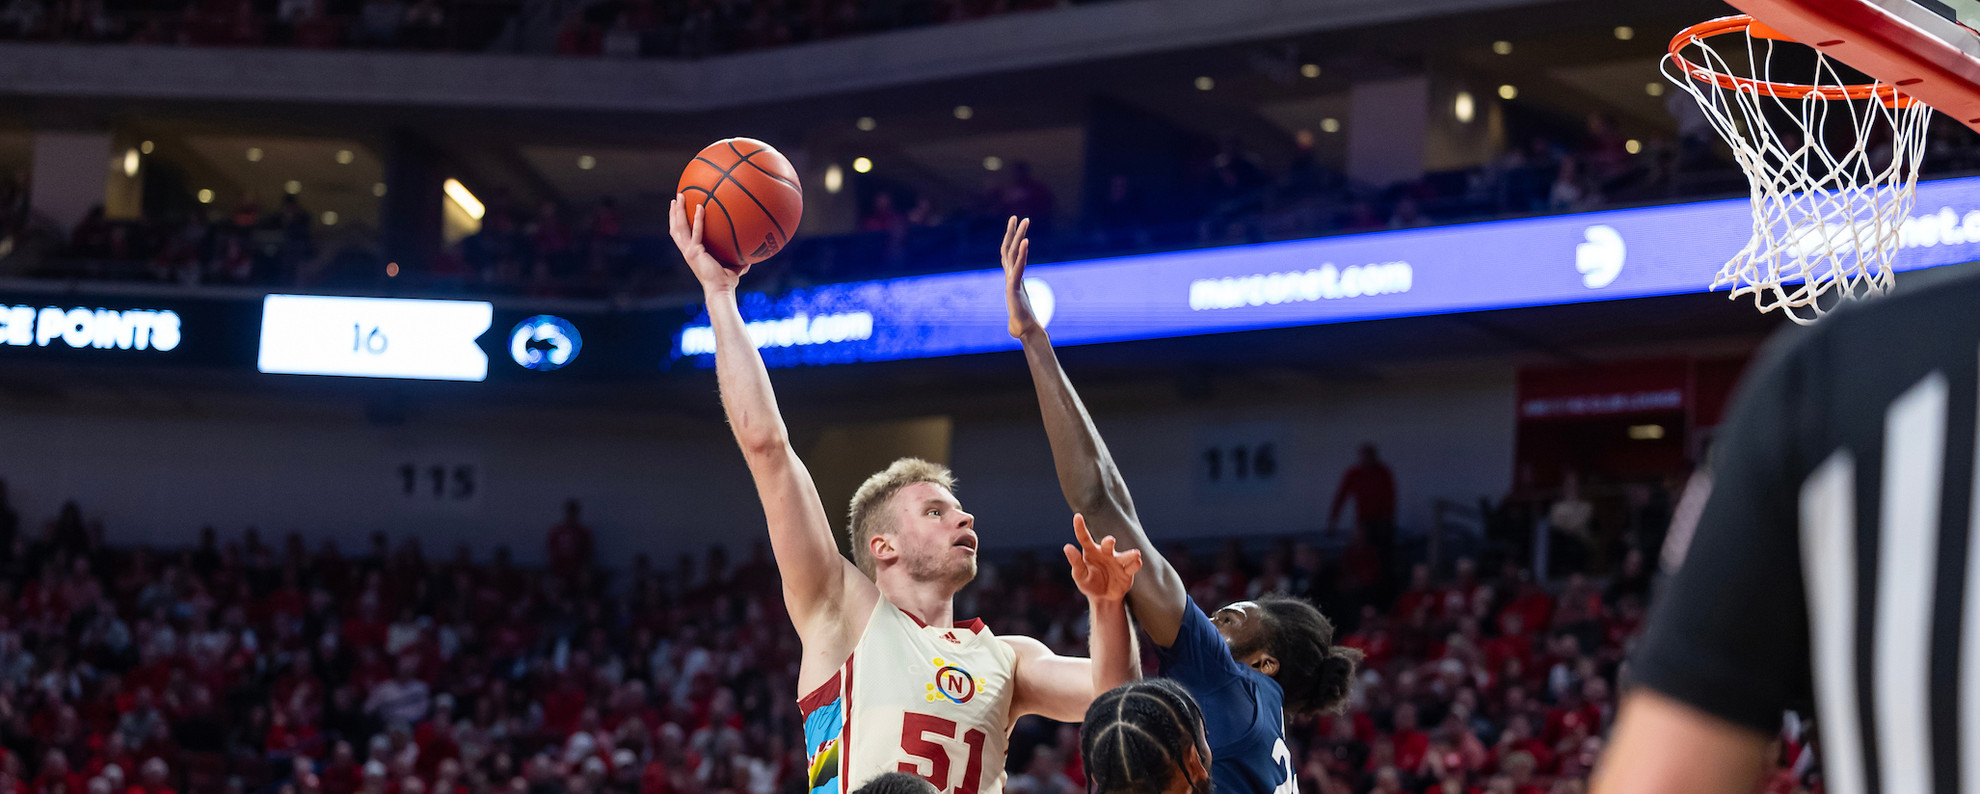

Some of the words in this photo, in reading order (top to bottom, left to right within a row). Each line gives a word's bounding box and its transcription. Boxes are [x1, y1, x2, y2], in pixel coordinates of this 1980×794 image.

[36, 305, 182, 351] POINTS
[353, 322, 388, 354] 16
[1202, 443, 1277, 480] 116
[397, 463, 475, 498] 115
[948, 675, 963, 694] N
[898, 711, 986, 794] 51
[1272, 737, 1300, 794] 2
